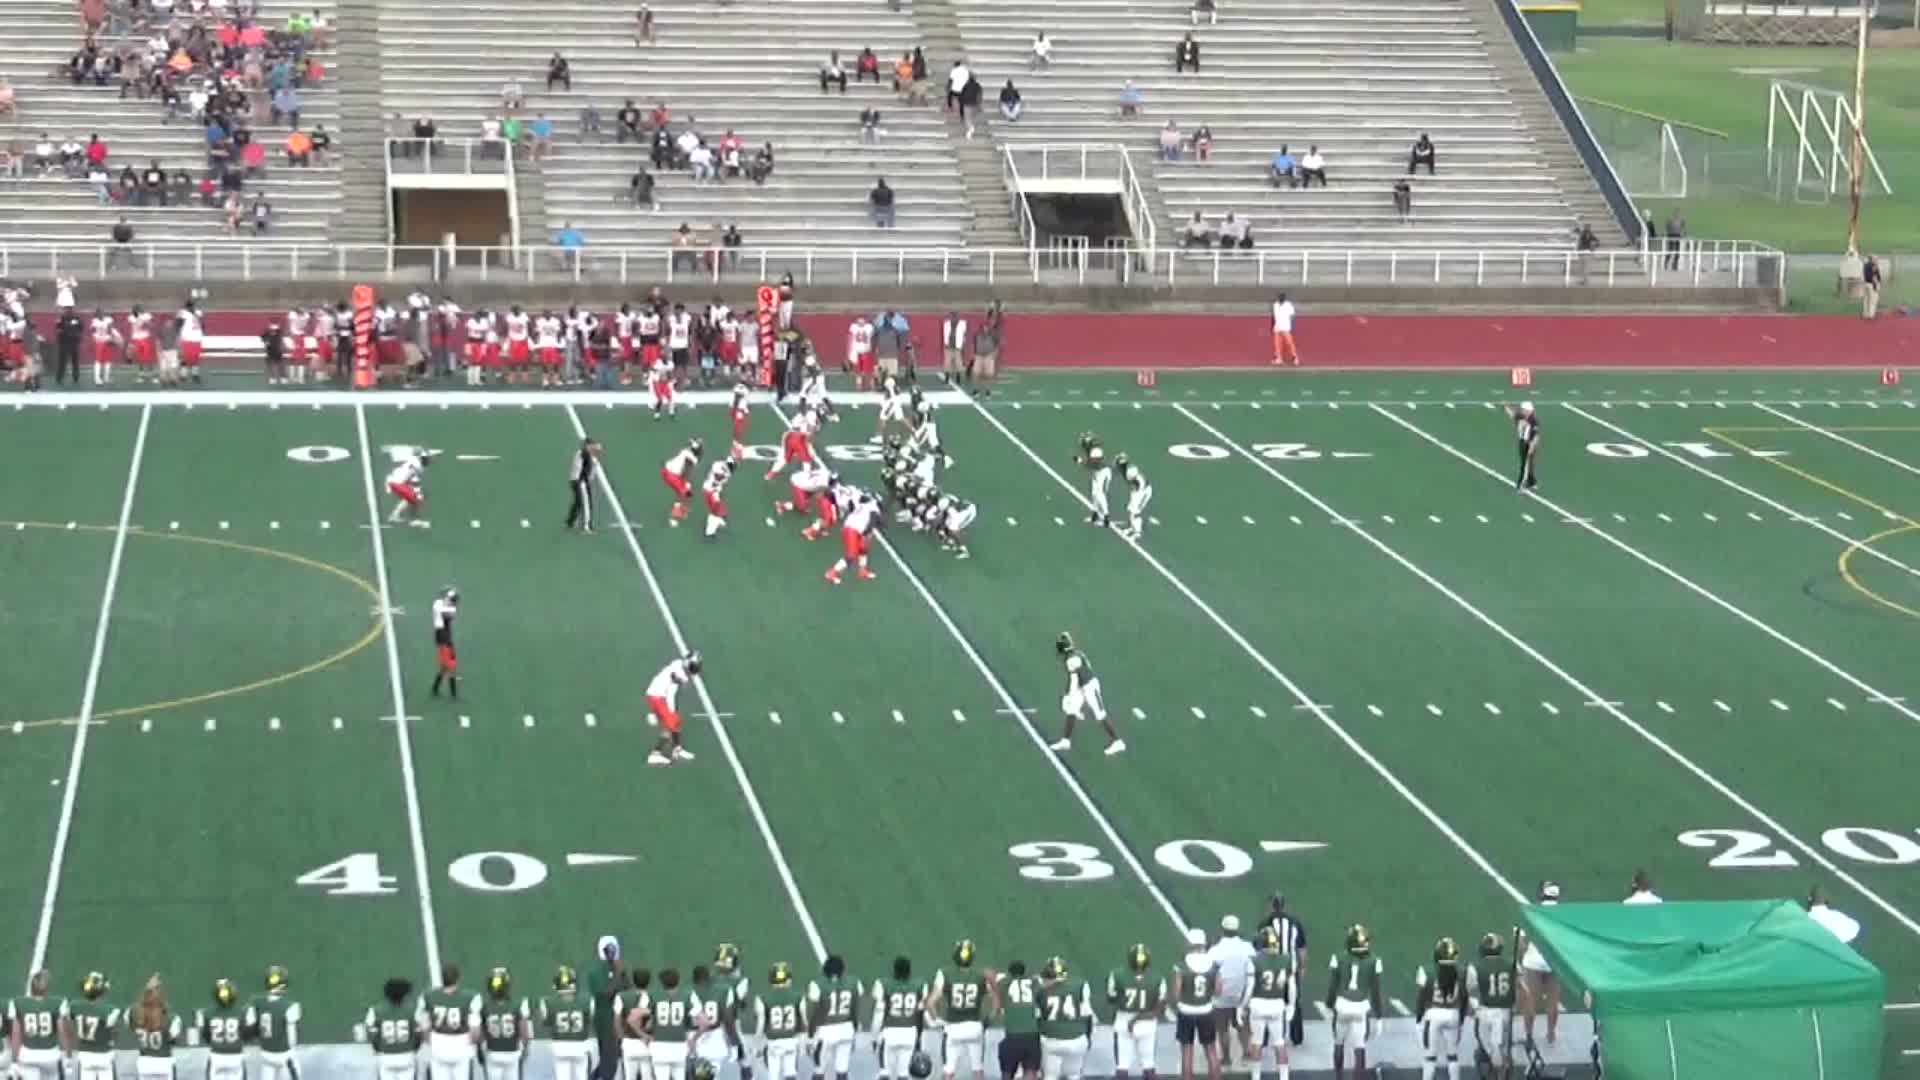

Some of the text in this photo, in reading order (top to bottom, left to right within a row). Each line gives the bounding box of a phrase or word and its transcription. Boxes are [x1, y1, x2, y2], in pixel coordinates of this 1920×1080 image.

[296, 851, 548, 895] 40
[1008, 839, 1254, 881] 30
[1007, 978, 1033, 1003] 45
[1261, 968, 1287, 991] 34
[1348, 964, 1360, 991] 1
[1487, 972, 1511, 997] 16
[827, 990, 853, 1017] 12
[951, 983, 979, 1009] 52
[1046, 993, 1076, 1021] 74
[1124, 987, 1147, 1010] 71
[655, 1000, 685, 1027] 80
[75, 1014, 100, 1041] 17
[209, 1017, 239, 1042] 28
